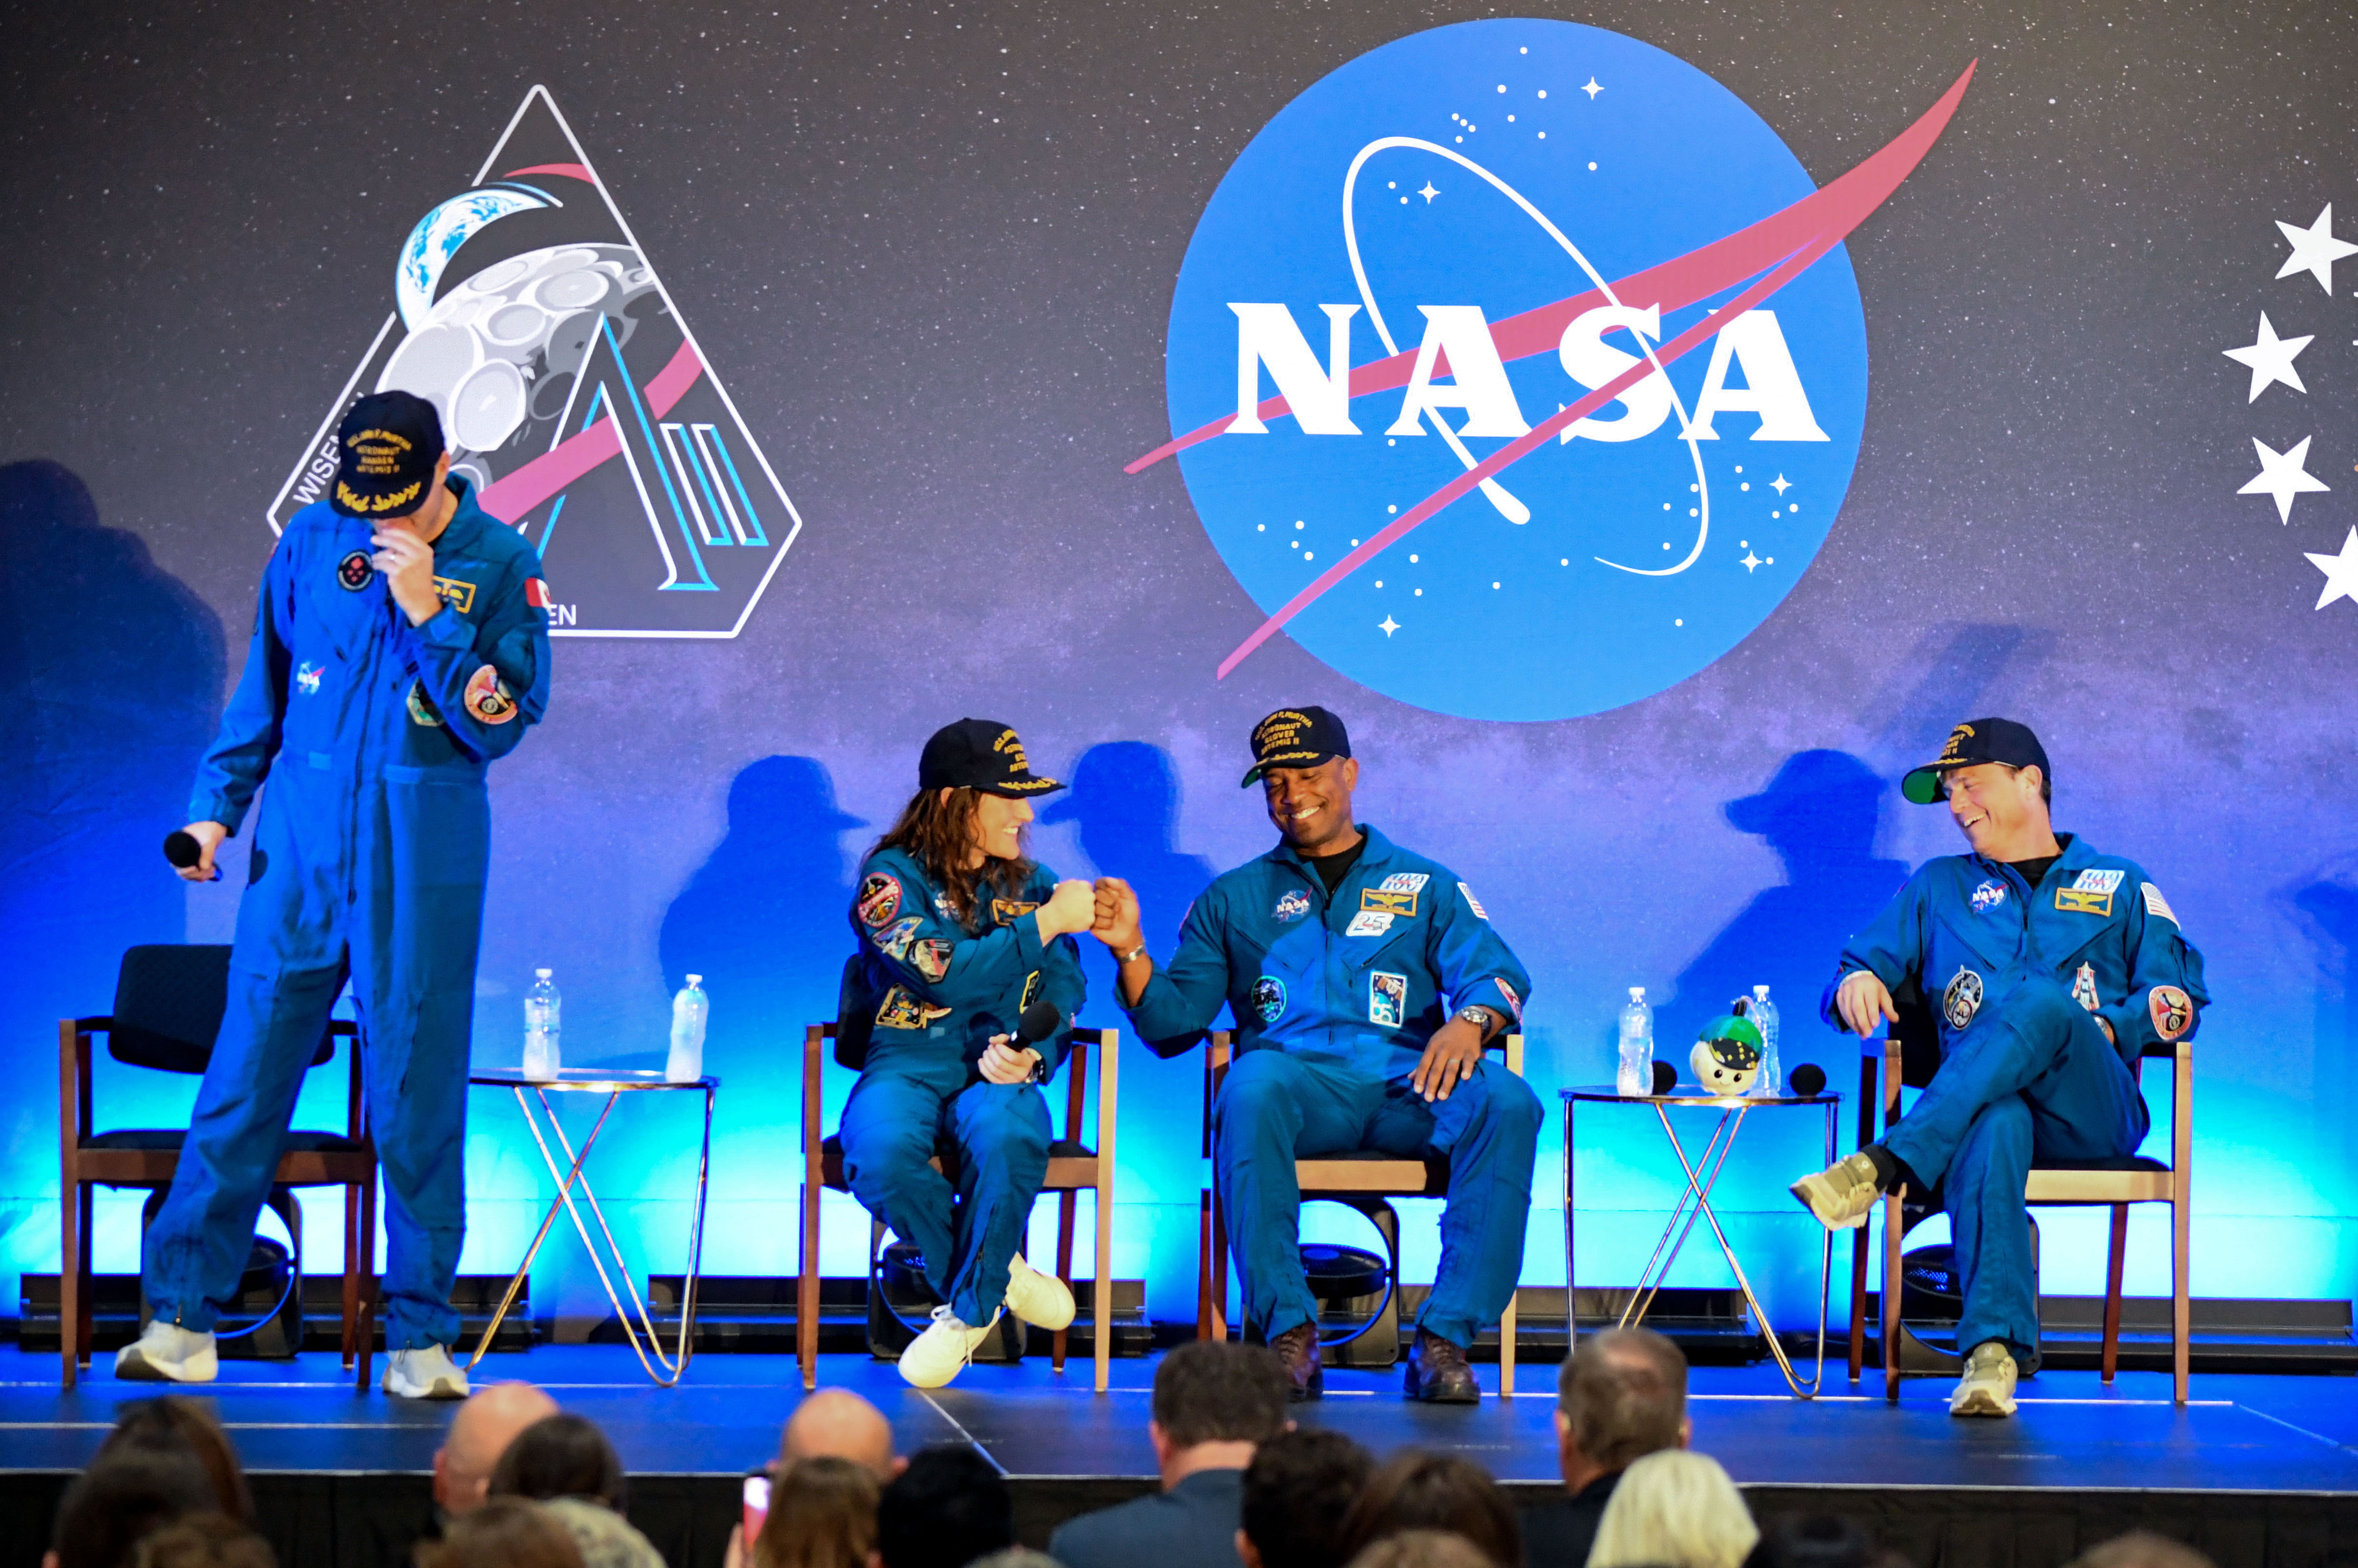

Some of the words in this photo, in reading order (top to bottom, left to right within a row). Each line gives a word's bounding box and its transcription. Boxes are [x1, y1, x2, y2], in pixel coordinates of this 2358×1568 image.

[1224, 302, 1831, 445] NASA
[1285, 711, 1313, 728] MURTHA
[1264, 730, 1295, 743] GLOVER
[1972, 888, 2004, 903] NASA
[1277, 899, 1310, 914] NASA
